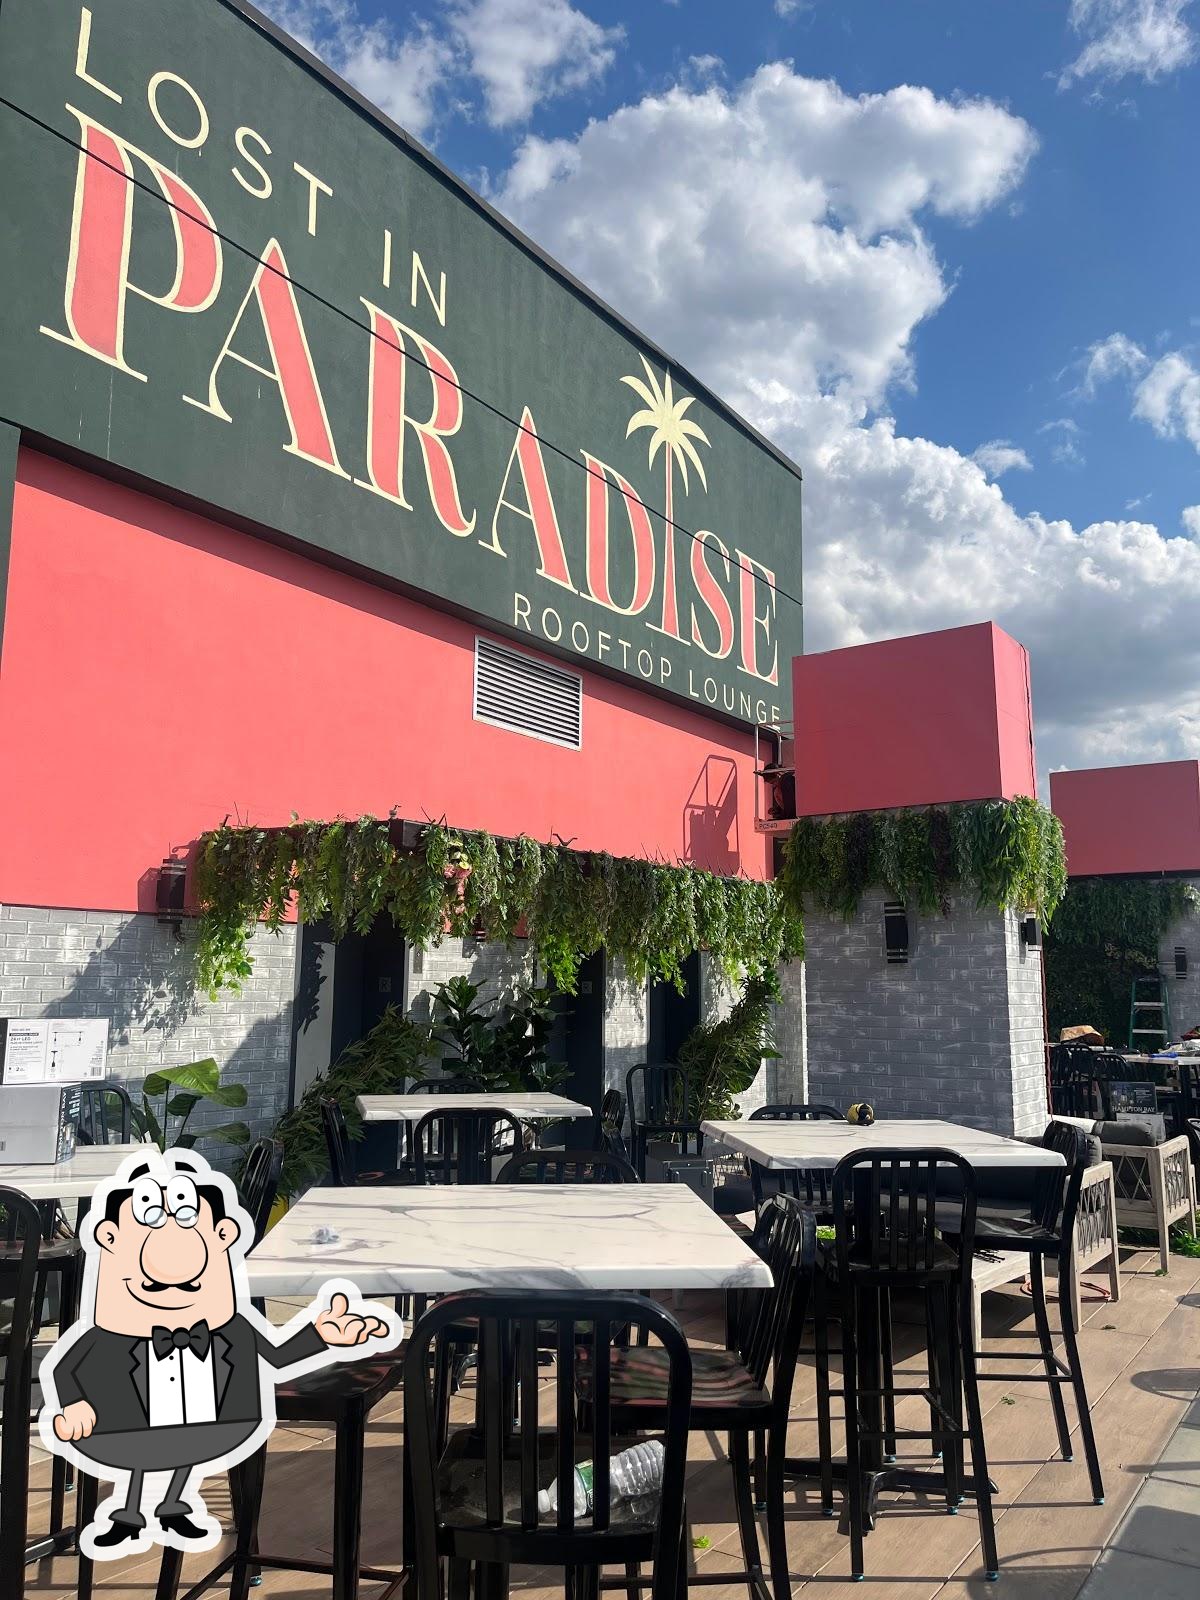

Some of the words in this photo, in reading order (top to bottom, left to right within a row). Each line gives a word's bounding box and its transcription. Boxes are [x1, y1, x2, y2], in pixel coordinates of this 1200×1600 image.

[74, 6, 333, 237] LOST
[382, 229, 446, 327] IN
[39, 102, 779, 686] PARADISE
[513, 592, 673, 685] ROOFTOP
[688, 669, 781, 730] LOUNGE
